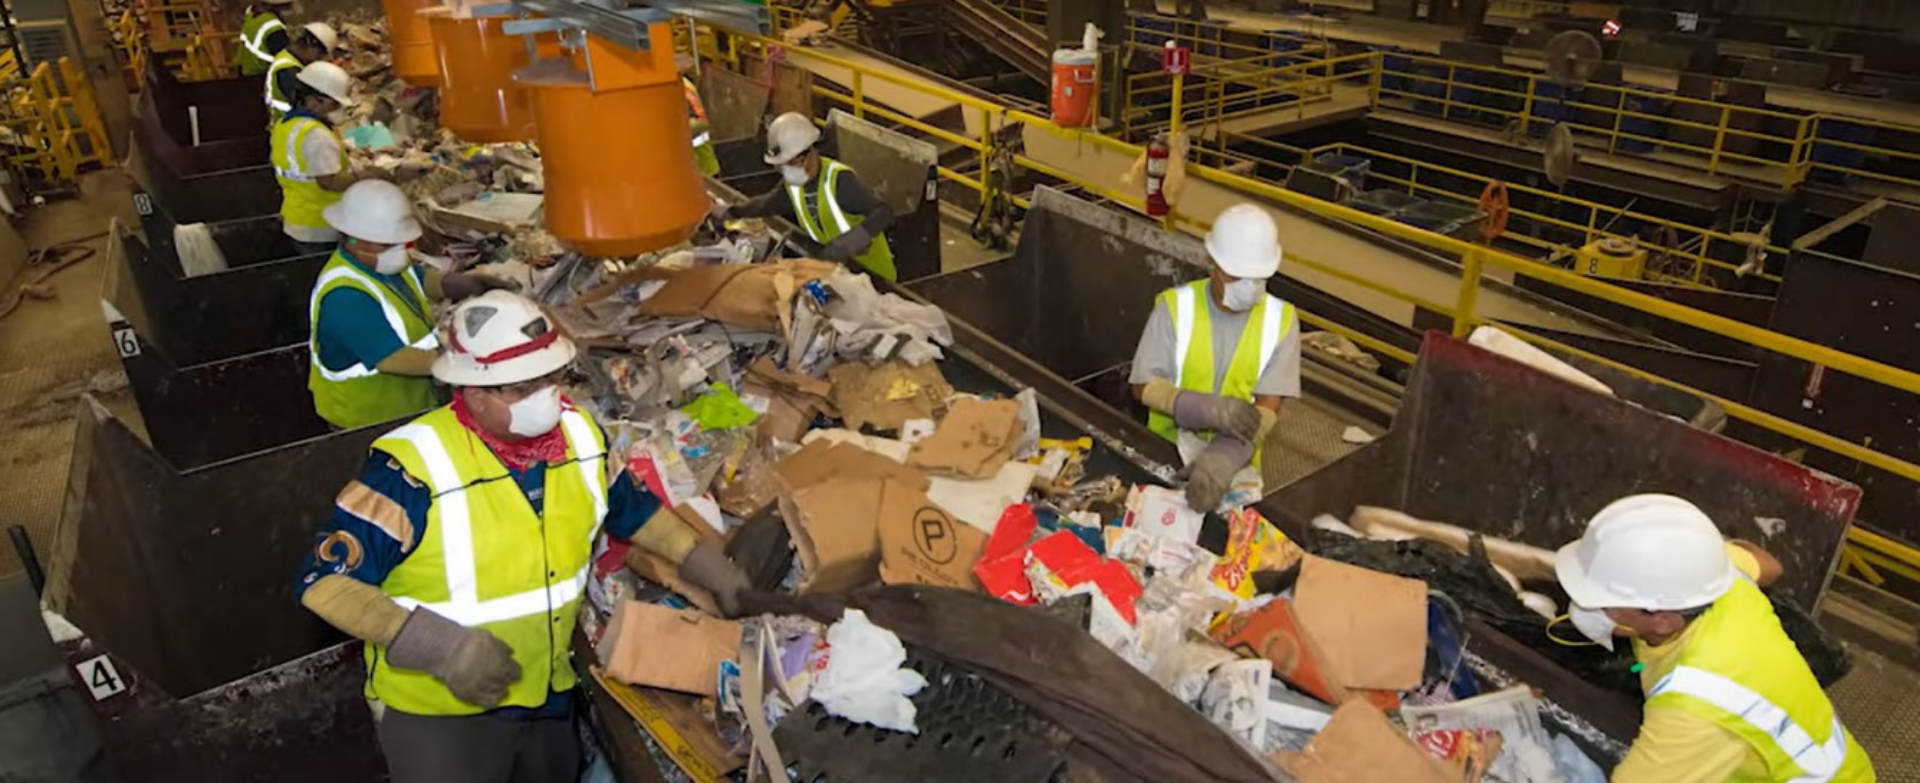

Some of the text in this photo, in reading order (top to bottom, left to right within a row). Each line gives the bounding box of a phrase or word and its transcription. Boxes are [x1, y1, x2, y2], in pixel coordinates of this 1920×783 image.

[137, 196, 149, 212] 8
[1589, 257, 1598, 274] 8
[121, 331, 136, 354] 6
[921, 519, 945, 551] P
[93, 660, 117, 692] 4
